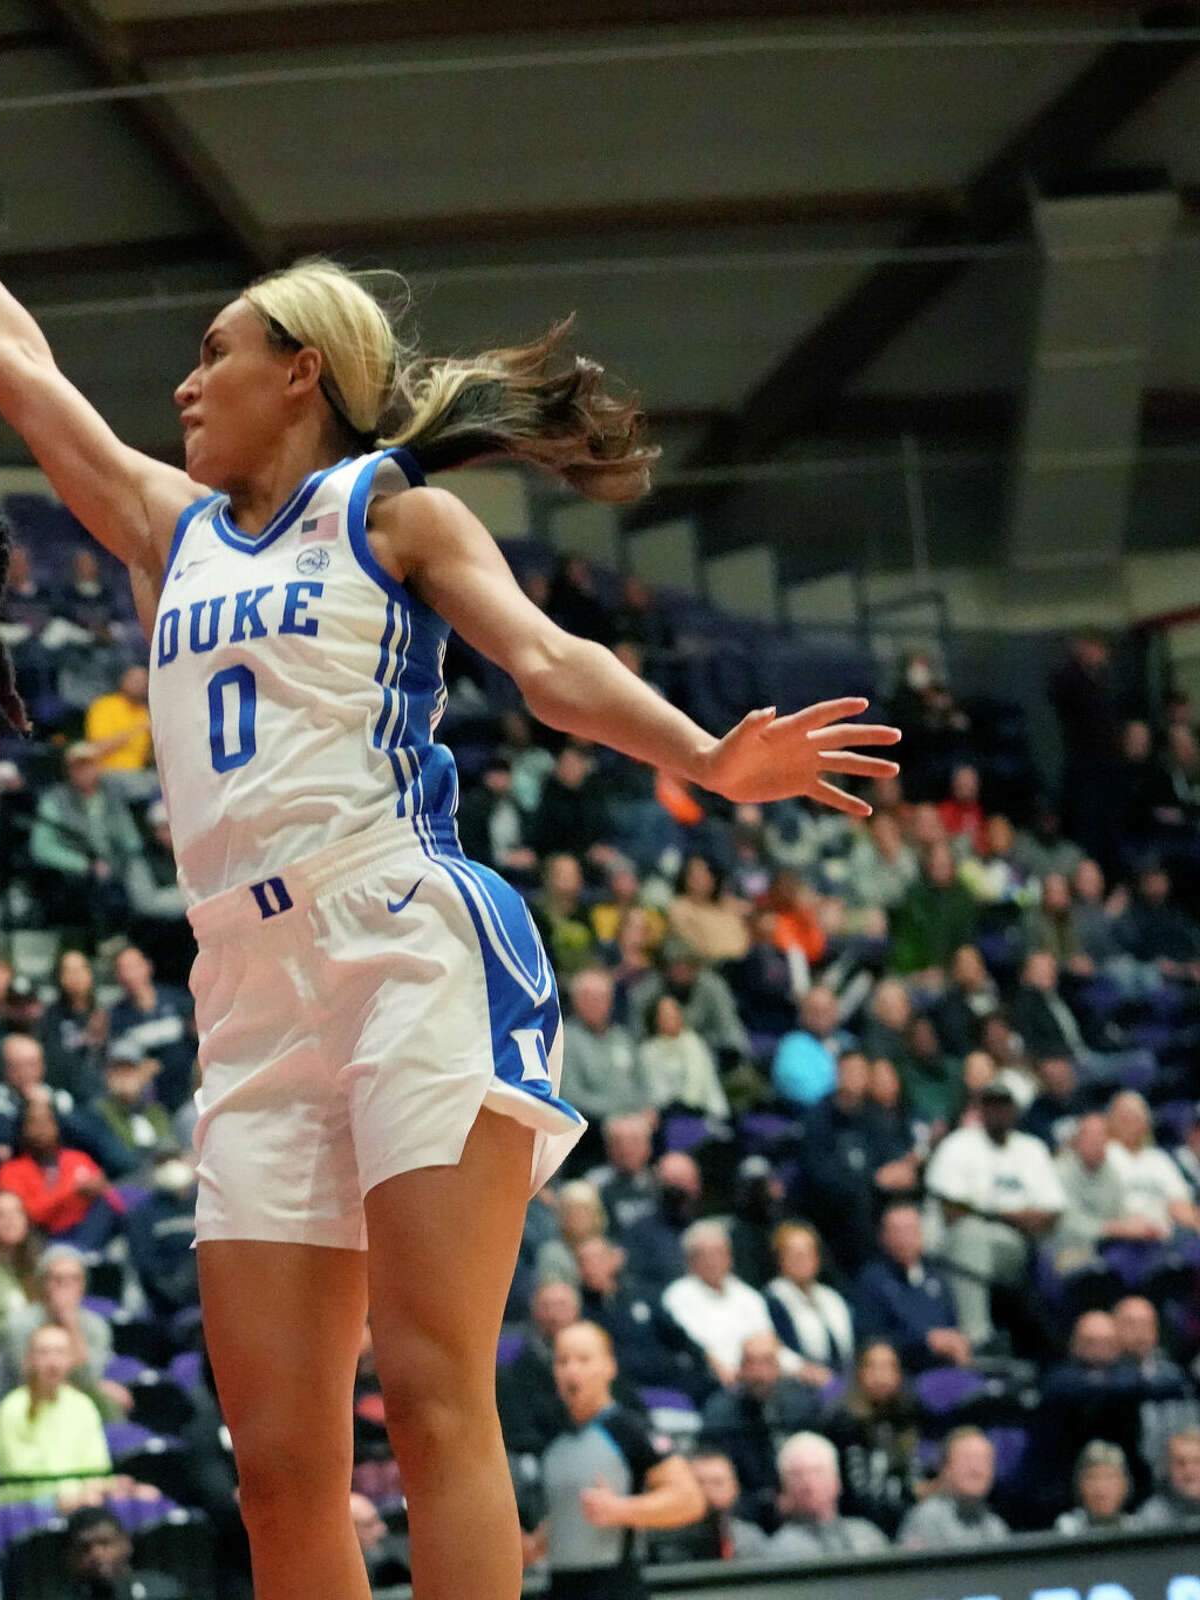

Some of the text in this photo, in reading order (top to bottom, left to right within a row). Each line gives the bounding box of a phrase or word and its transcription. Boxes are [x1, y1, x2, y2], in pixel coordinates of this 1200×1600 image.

[157, 581, 324, 669] DUKE
[207, 664, 257, 775] 0
[249, 876, 294, 920] D
